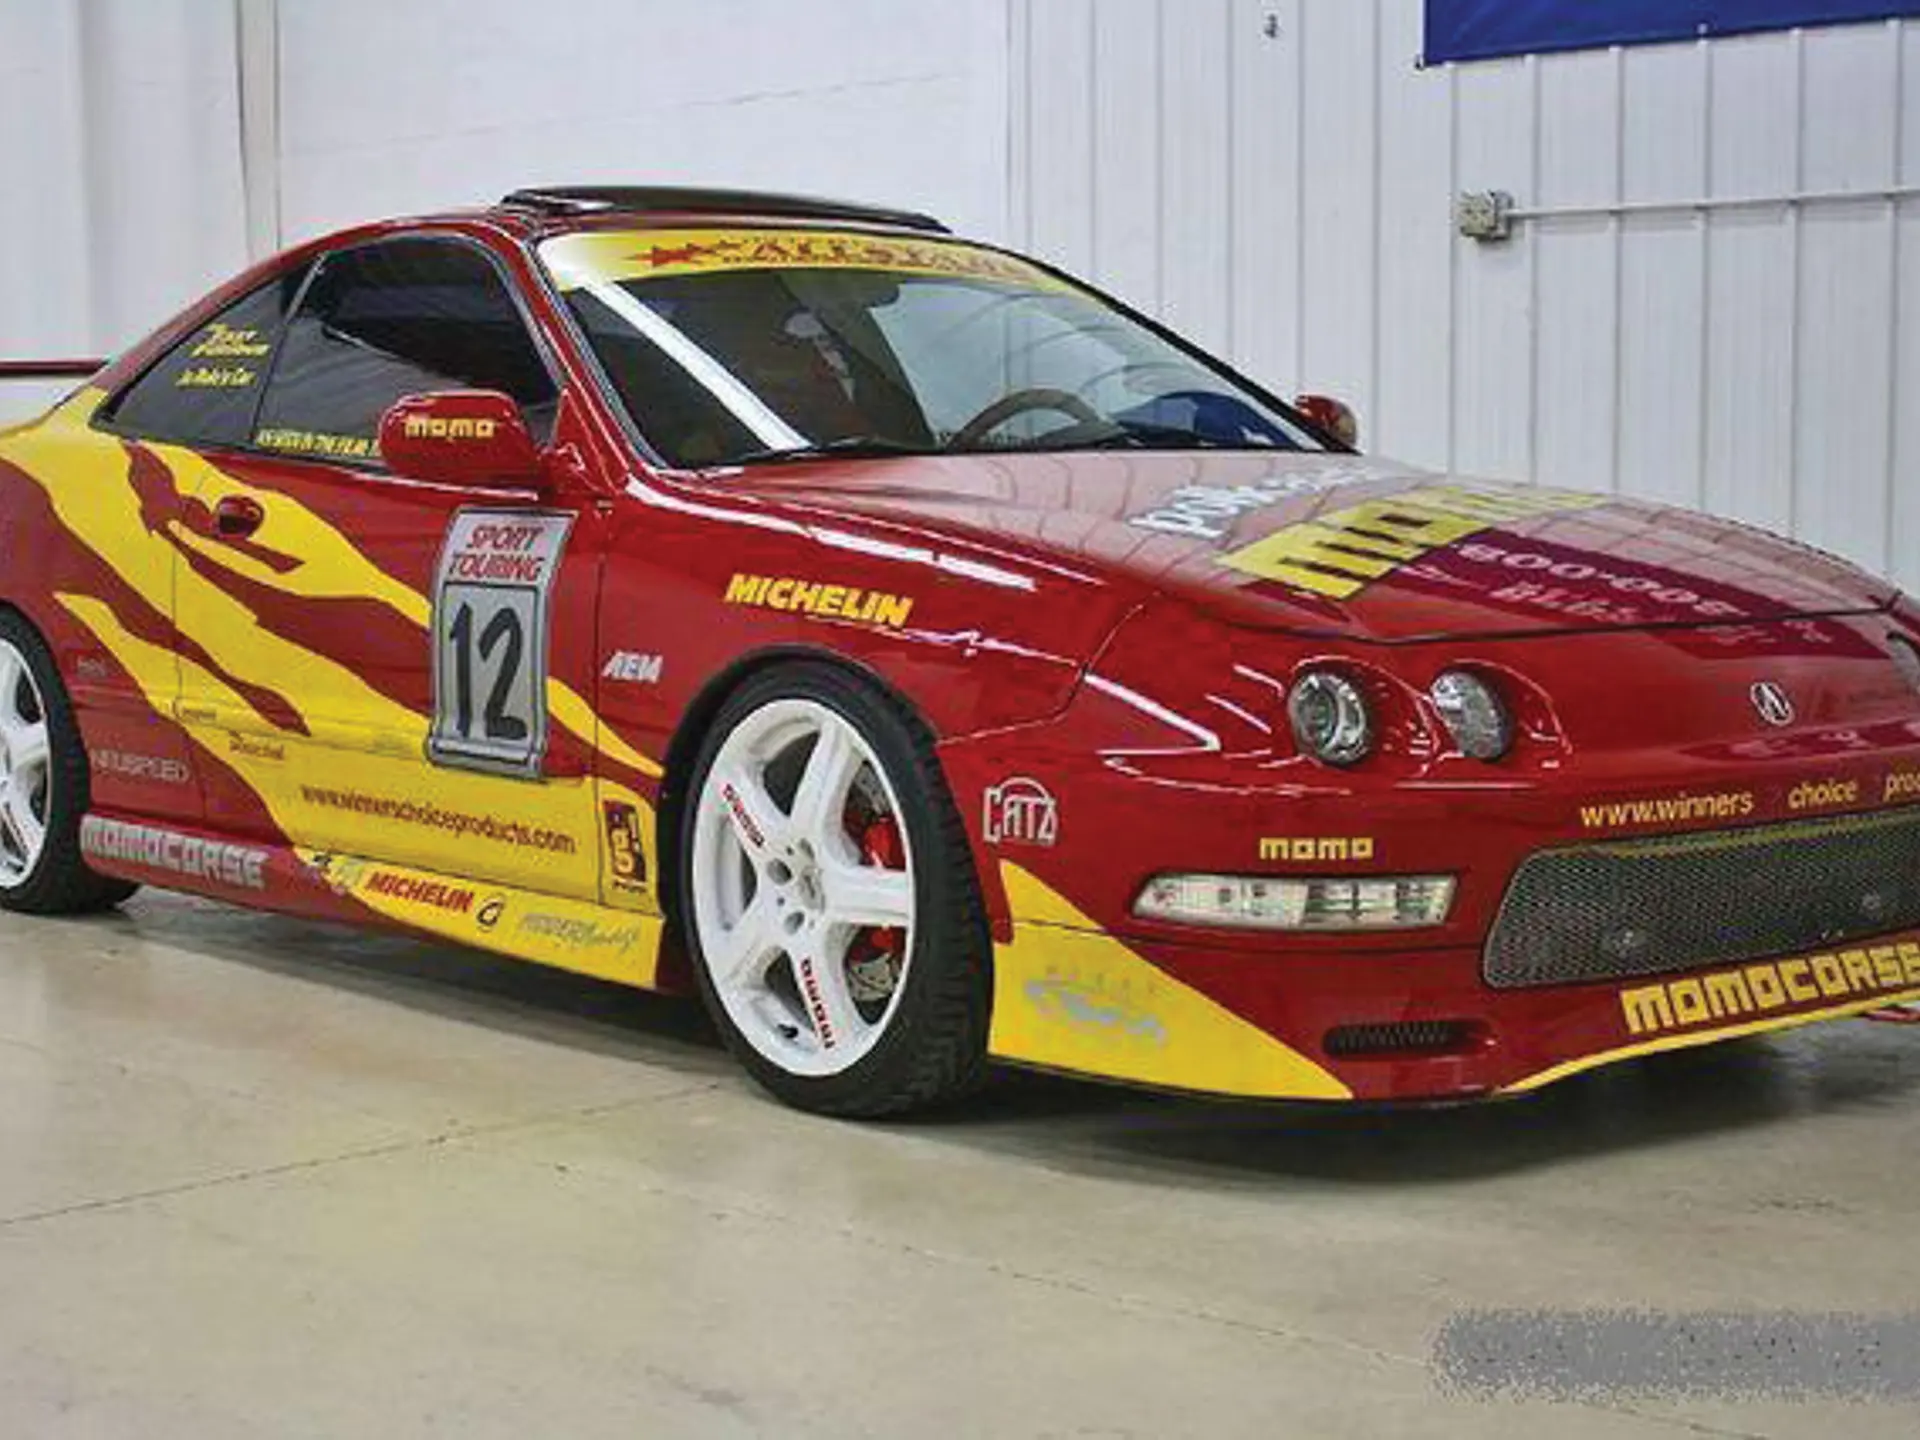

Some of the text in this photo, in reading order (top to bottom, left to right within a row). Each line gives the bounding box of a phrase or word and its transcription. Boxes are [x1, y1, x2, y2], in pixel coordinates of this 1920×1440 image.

[466, 524, 543, 549] SPORT
[449, 552, 544, 580] TOURING
[724, 573, 914, 629] MICHELIN
[450, 601, 528, 738] 12
[1579, 789, 1756, 827] www.winners
[1787, 776, 1858, 810] choice
[1260, 836, 1374, 860] momo
[364, 870, 474, 913] MICHELIN
